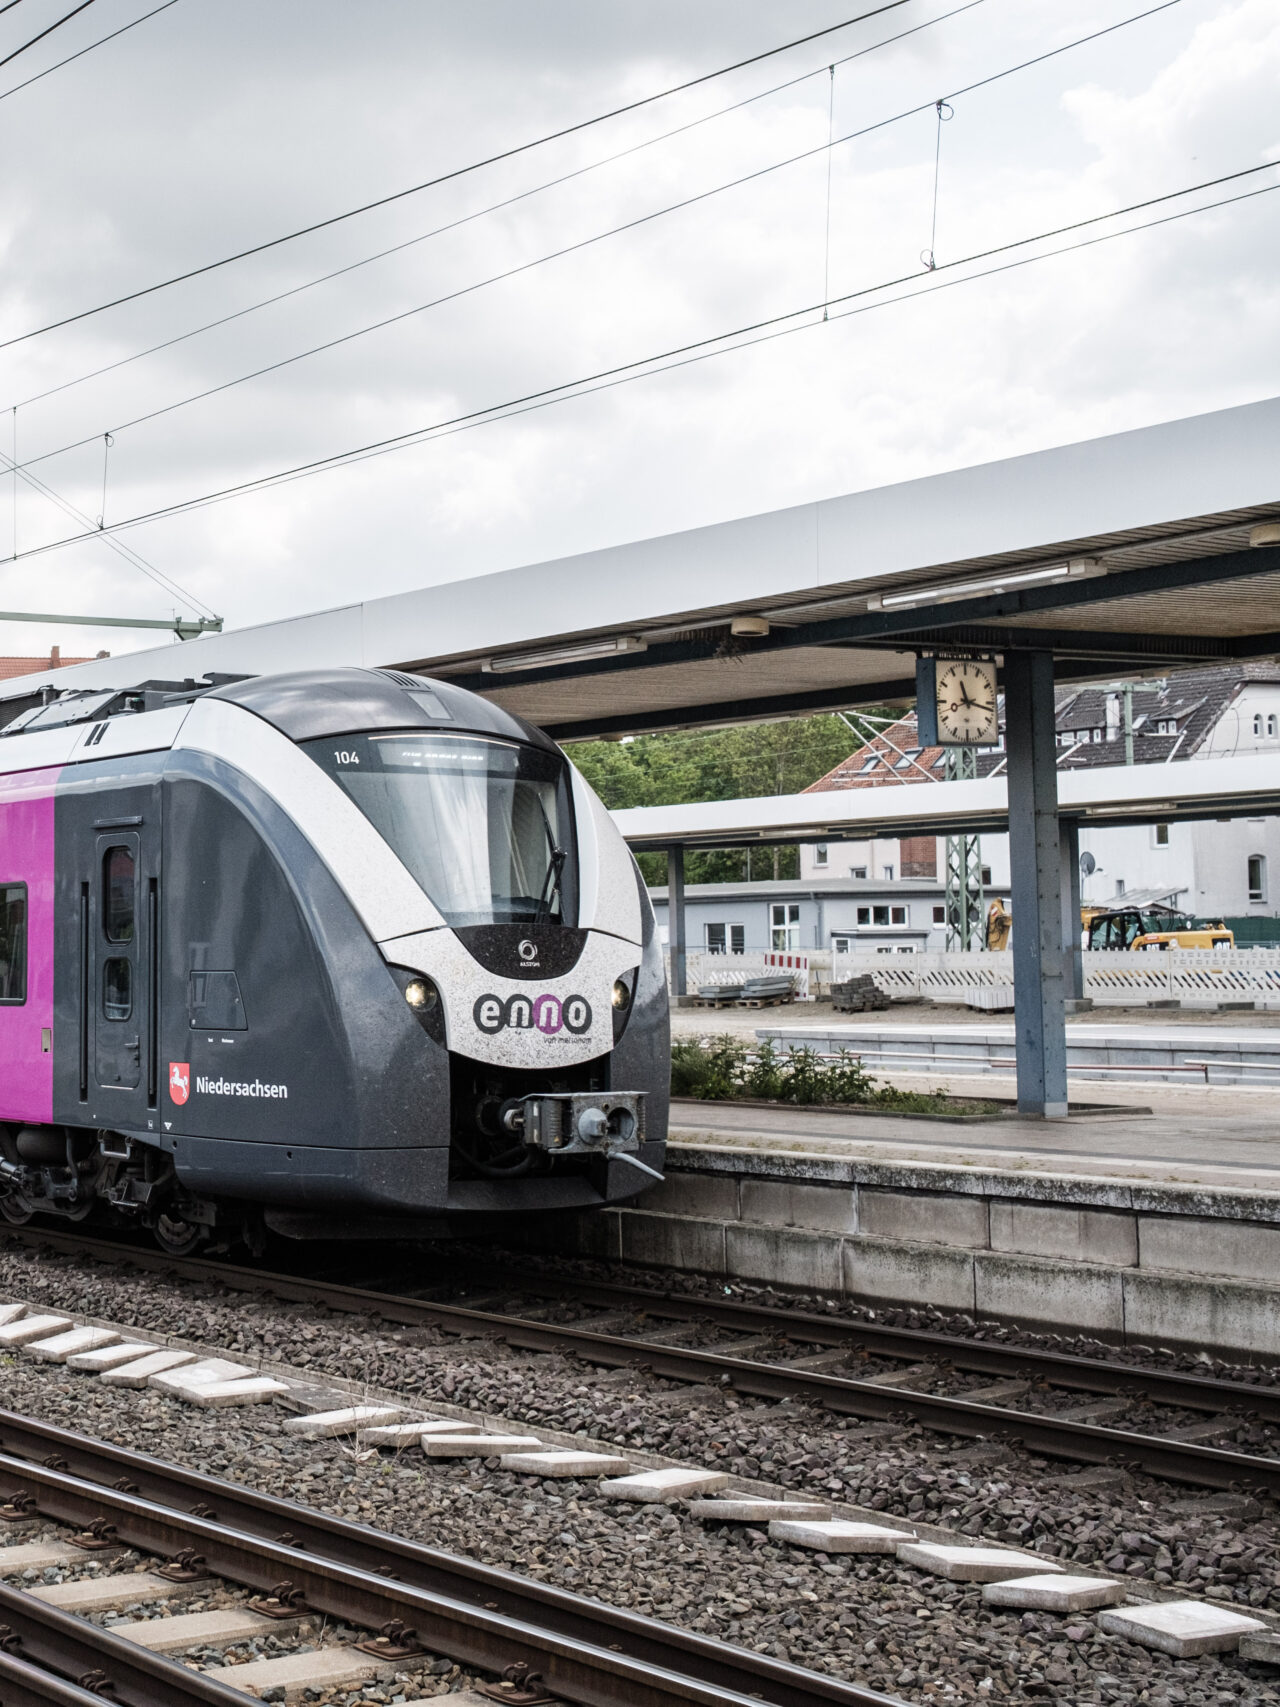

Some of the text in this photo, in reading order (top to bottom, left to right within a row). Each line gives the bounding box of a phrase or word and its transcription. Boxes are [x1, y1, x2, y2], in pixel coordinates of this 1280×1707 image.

[334, 751, 359, 764] 104
[475, 996, 590, 1032] enno
[196, 1076, 288, 1099] Niedersachsen
